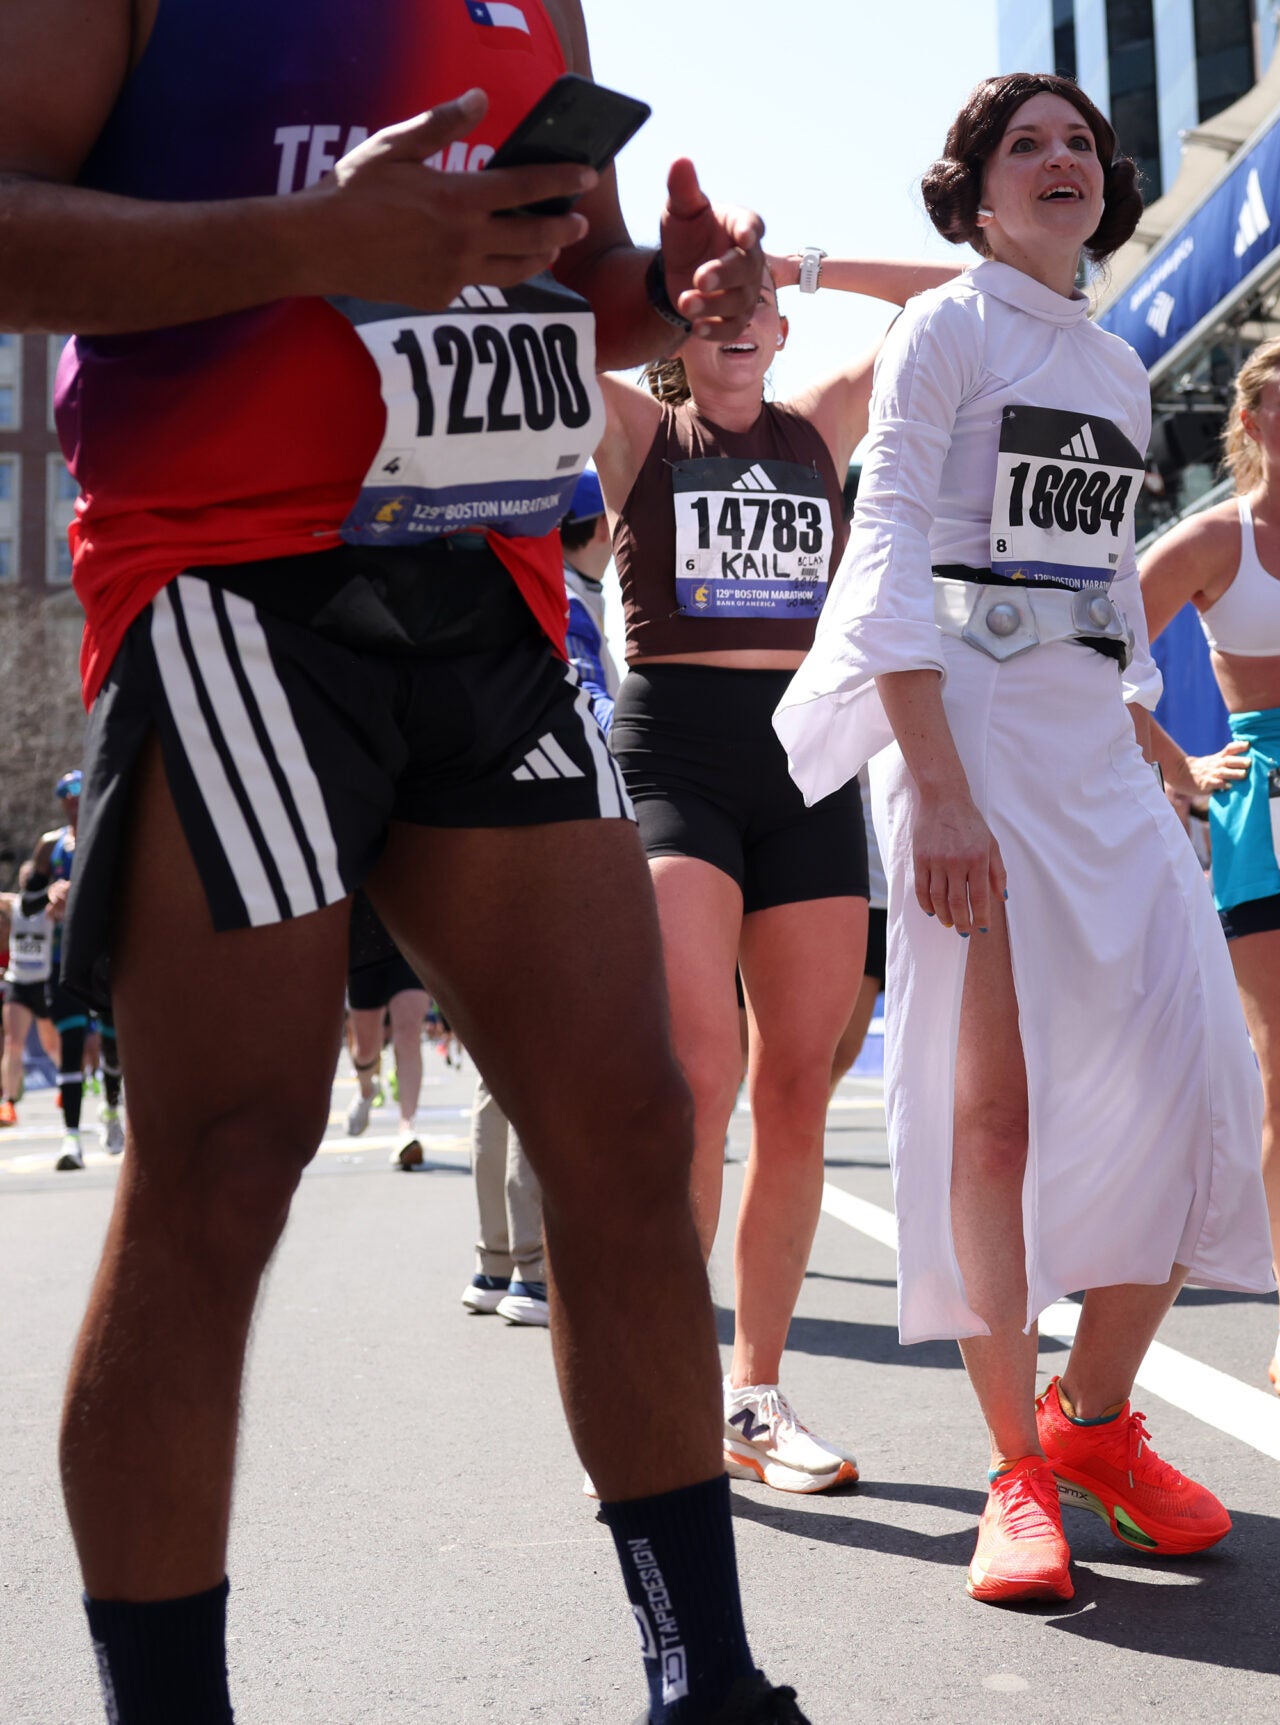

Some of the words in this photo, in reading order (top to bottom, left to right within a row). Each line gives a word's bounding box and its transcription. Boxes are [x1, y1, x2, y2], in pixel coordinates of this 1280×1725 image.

[392, 323, 591, 437] 12200
[382, 456, 401, 475] 4
[445, 502, 499, 520] BOSTON
[500, 492, 561, 515] MARATHON
[1009, 461, 1133, 537] 16094
[690, 497, 823, 554] 14783
[996, 538, 1007, 552] 8
[685, 559, 696, 571] 6
[721, 551, 790, 580] KAIL
[734, 589, 769, 599] BOSTON
[771, 590, 813, 600] MARATHON
[627, 1538, 681, 1649] TAPEDESIGN
